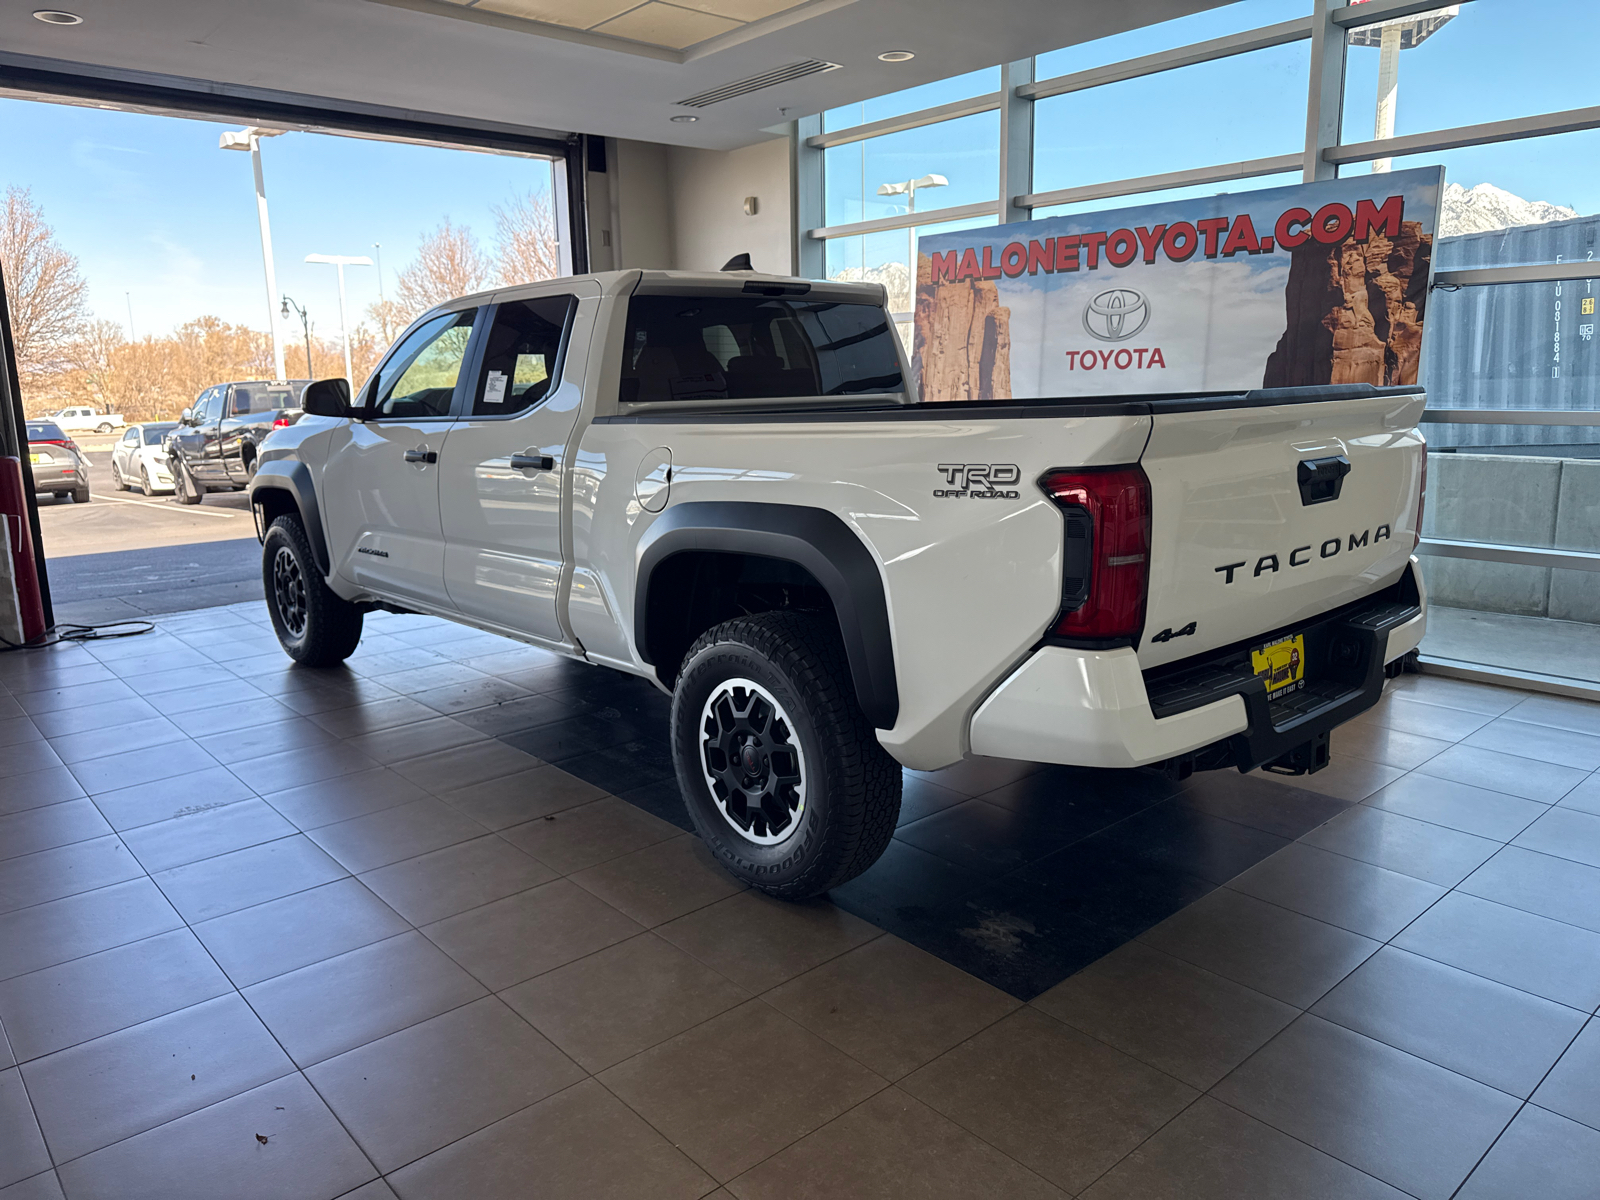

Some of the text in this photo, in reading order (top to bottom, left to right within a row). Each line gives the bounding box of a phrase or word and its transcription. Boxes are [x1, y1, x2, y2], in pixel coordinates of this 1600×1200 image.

[931, 195, 1405, 285] MALONETOYOTA.COM
[1555, 255, 1563, 297] FU
[1065, 347, 1166, 371] TOYOTA
[933, 489, 1020, 499] OFF ROAD
[937, 463, 1021, 490] TRD
[1214, 522, 1392, 585] TACOMA
[711, 806, 820, 877] BFGoodrich
